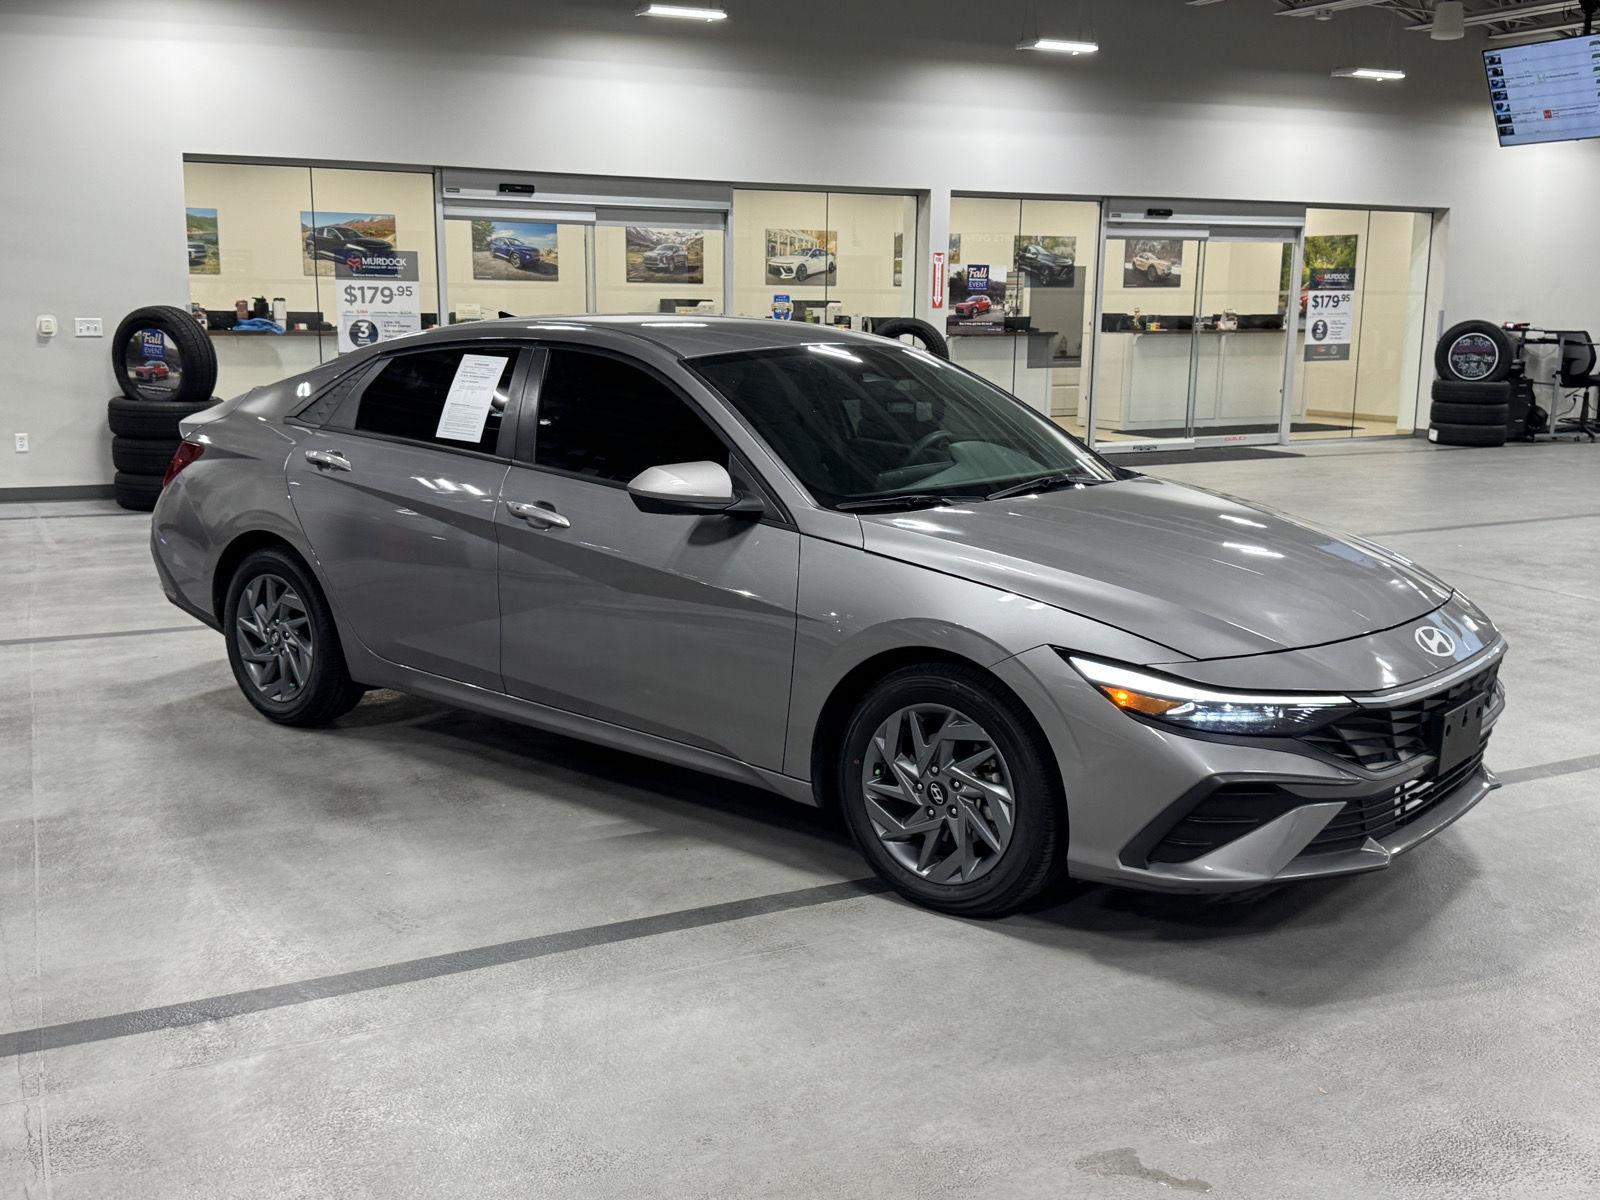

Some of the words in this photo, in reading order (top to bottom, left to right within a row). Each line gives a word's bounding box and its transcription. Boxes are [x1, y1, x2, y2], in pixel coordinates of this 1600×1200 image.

[361, 257, 407, 266] MURDOCK
[968, 267, 988, 278] Fall
[1324, 273, 1350, 281] MURDOCK
[357, 322, 370, 338] 3
[1316, 321, 1324, 334] 3
[142, 332, 162, 345] Fall
[144, 347, 162, 355] EVENT
